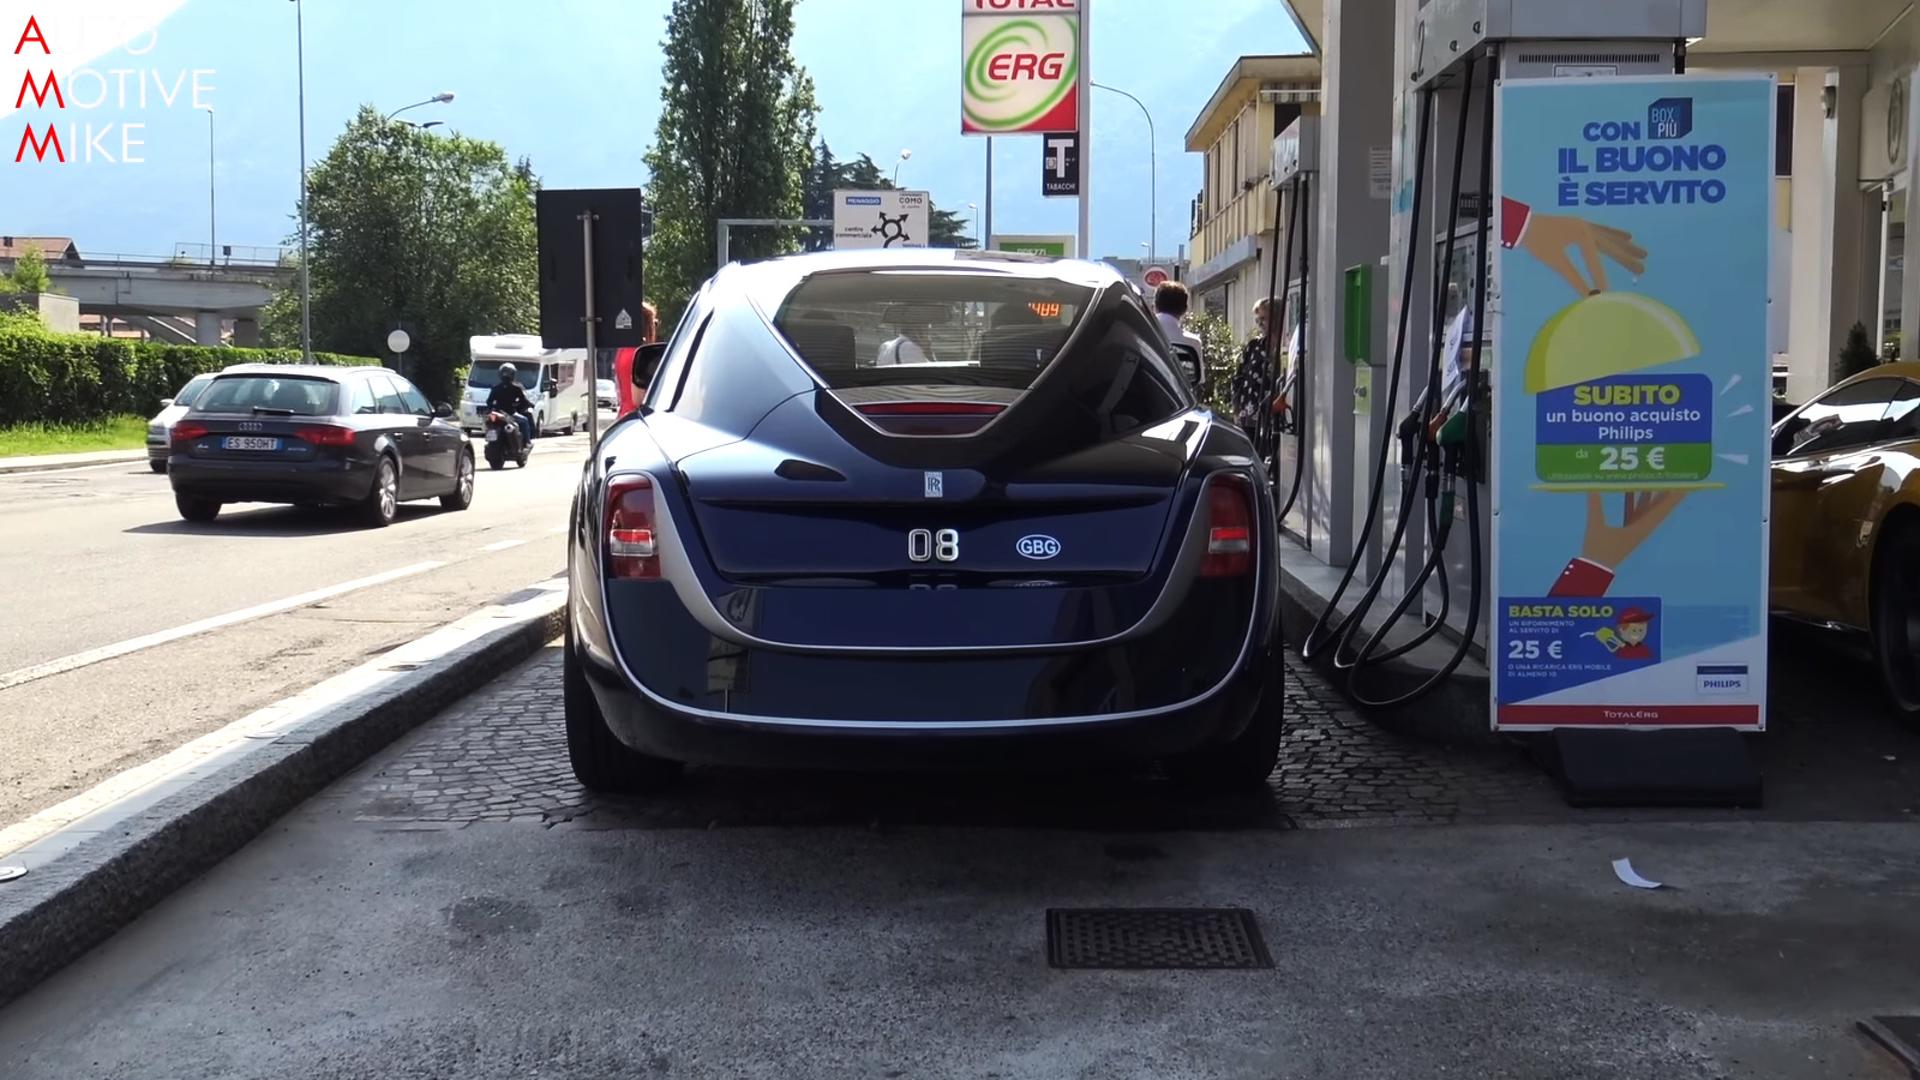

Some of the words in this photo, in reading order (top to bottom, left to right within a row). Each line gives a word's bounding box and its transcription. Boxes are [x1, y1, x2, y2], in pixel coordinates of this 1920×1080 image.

[988, 53, 1065, 81] ERG
[1652, 108, 1674, 123] BOX
[1583, 122, 1640, 141] CON
[1048, 139, 1074, 178] T
[1558, 148, 1589, 174] IL
[1596, 144, 1727, 173] BUONO
[1558, 176, 1579, 207] È
[1585, 179, 1727, 206] SERVITO
[1573, 384, 1681, 406] SUBITO
[1546, 411, 1566, 423] un
[1571, 408, 1625, 423] buono
[1630, 408, 1701, 425] acquisto
[1598, 427, 1654, 442] Philips
[1575, 448, 1589, 459] da
[1599, 446, 1640, 471] 25
[1646, 446, 1665, 471] €
[908, 529, 959, 562] 08
[1020, 540, 1057, 555] GBG
[1508, 605, 1565, 618] BASTA
[1567, 605, 1614, 618] SOLO
[1508, 640, 1540, 660] 25
[1547, 640, 1563, 660] €
[1703, 680, 1741, 689] PHILIPS
